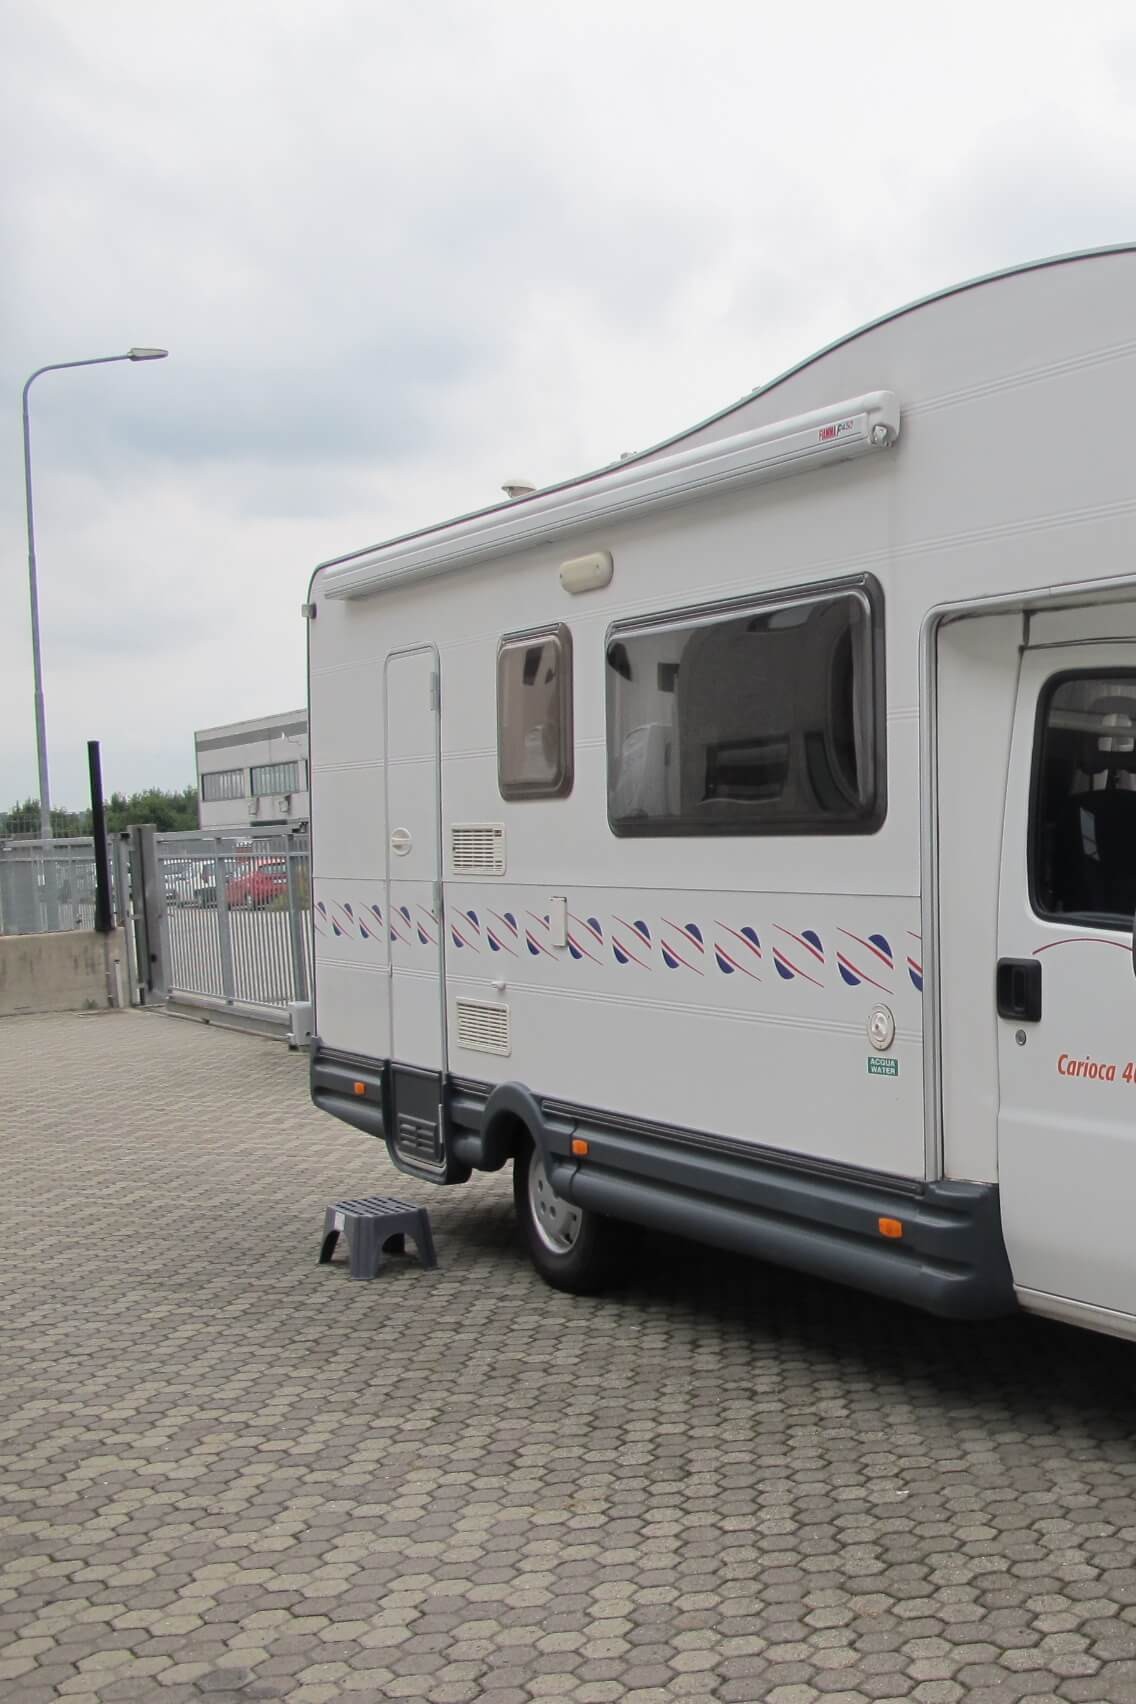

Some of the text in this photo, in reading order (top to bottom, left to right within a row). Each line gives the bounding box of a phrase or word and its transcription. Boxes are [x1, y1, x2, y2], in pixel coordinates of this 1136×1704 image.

[870, 1057, 896, 1067] ACQUA
[1057, 1054, 1116, 1081] Carioca
[870, 1065, 896, 1076] WATER
